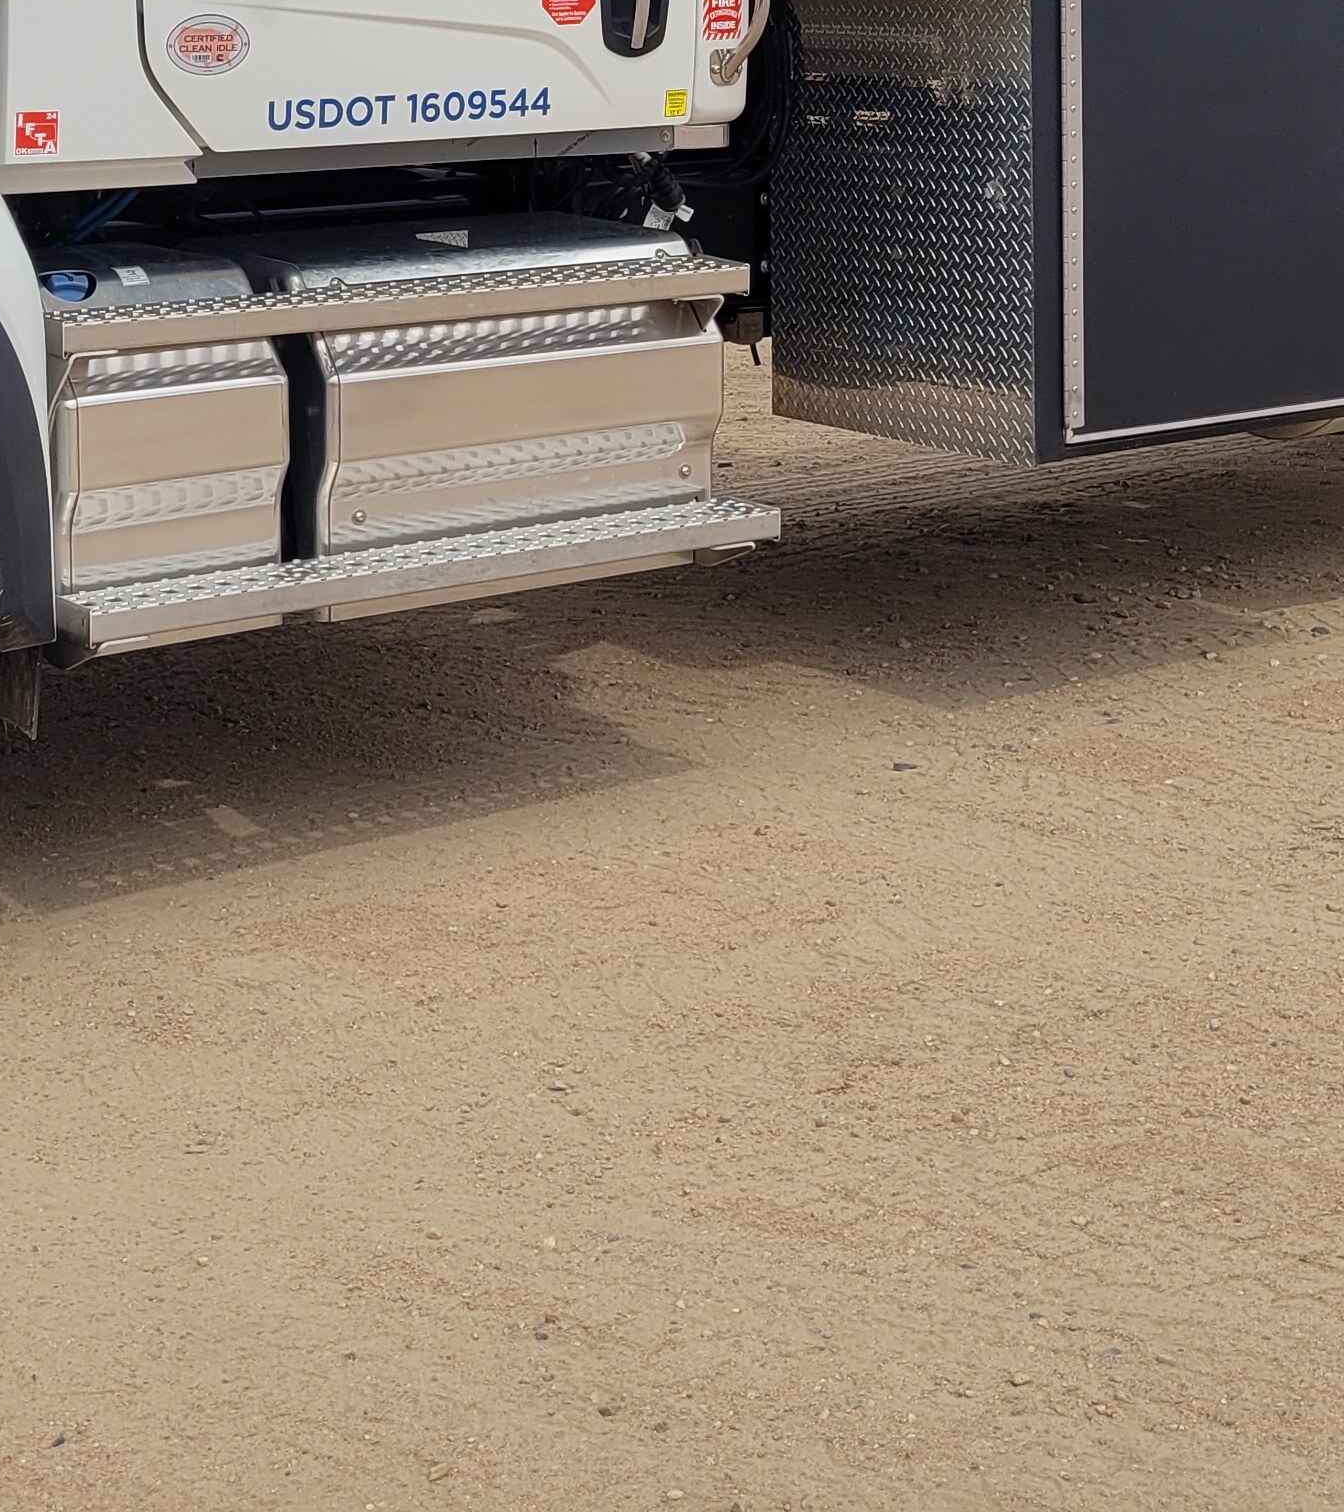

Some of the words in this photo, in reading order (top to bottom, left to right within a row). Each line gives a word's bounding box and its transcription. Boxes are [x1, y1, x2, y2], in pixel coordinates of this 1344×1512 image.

[184, 34, 234, 43] CERTIFIED
[179, 44, 212, 53] CLEAN
[216, 43, 238, 52] IDLE
[268, 94, 396, 131] USDOT
[408, 87, 551, 123] 1609544
[45, 112, 57, 120] 24
